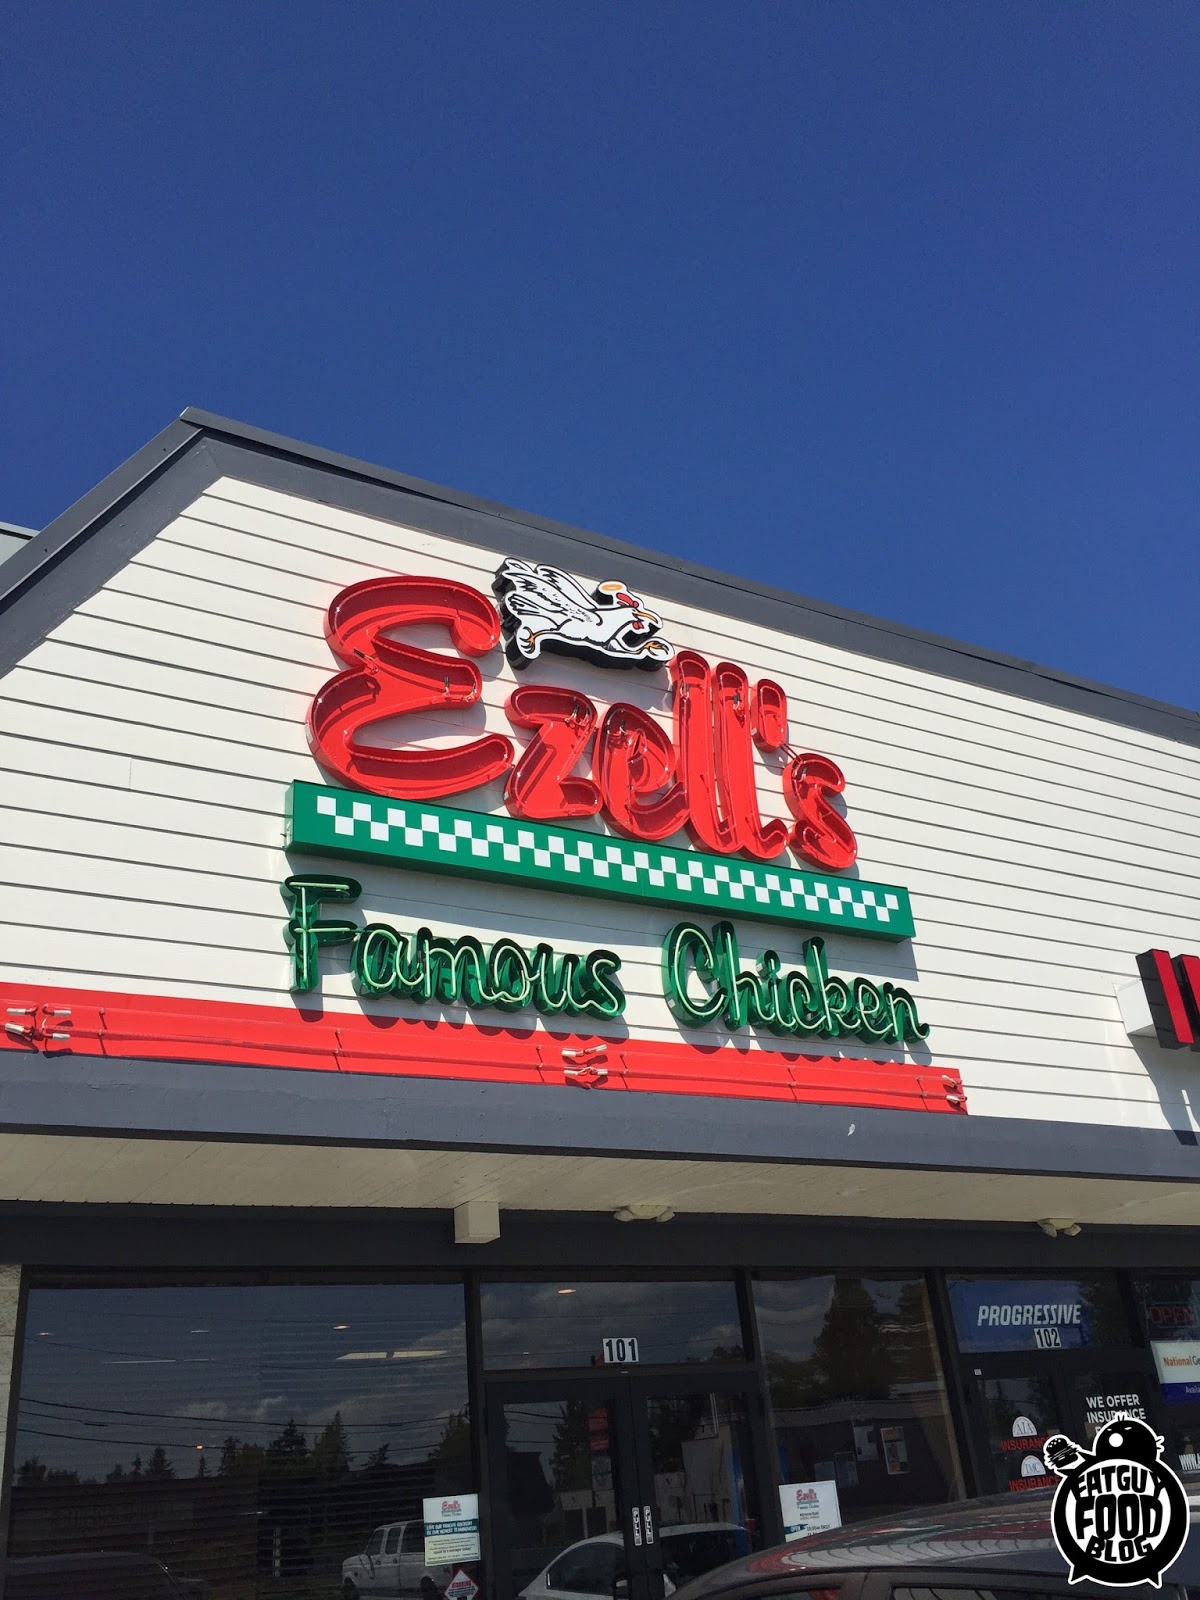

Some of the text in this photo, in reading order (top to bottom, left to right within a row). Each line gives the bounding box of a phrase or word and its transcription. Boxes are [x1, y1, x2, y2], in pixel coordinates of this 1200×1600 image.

[305, 575, 858, 871] Ezell's
[280, 874, 930, 1044] Famous Chicken
[977, 1304, 1081, 1326] PROGRESSIVE
[1036, 1328, 1060, 1348] 102
[605, 1338, 637, 1362] 101
[1162, 1355, 1192, 1367] National
[1086, 1394, 1140, 1409] WE OFFER
[1087, 1408, 1146, 1423] INSURNCE
[1016, 1421, 1034, 1435] AIA
[1001, 1434, 1049, 1452] INSURANC
